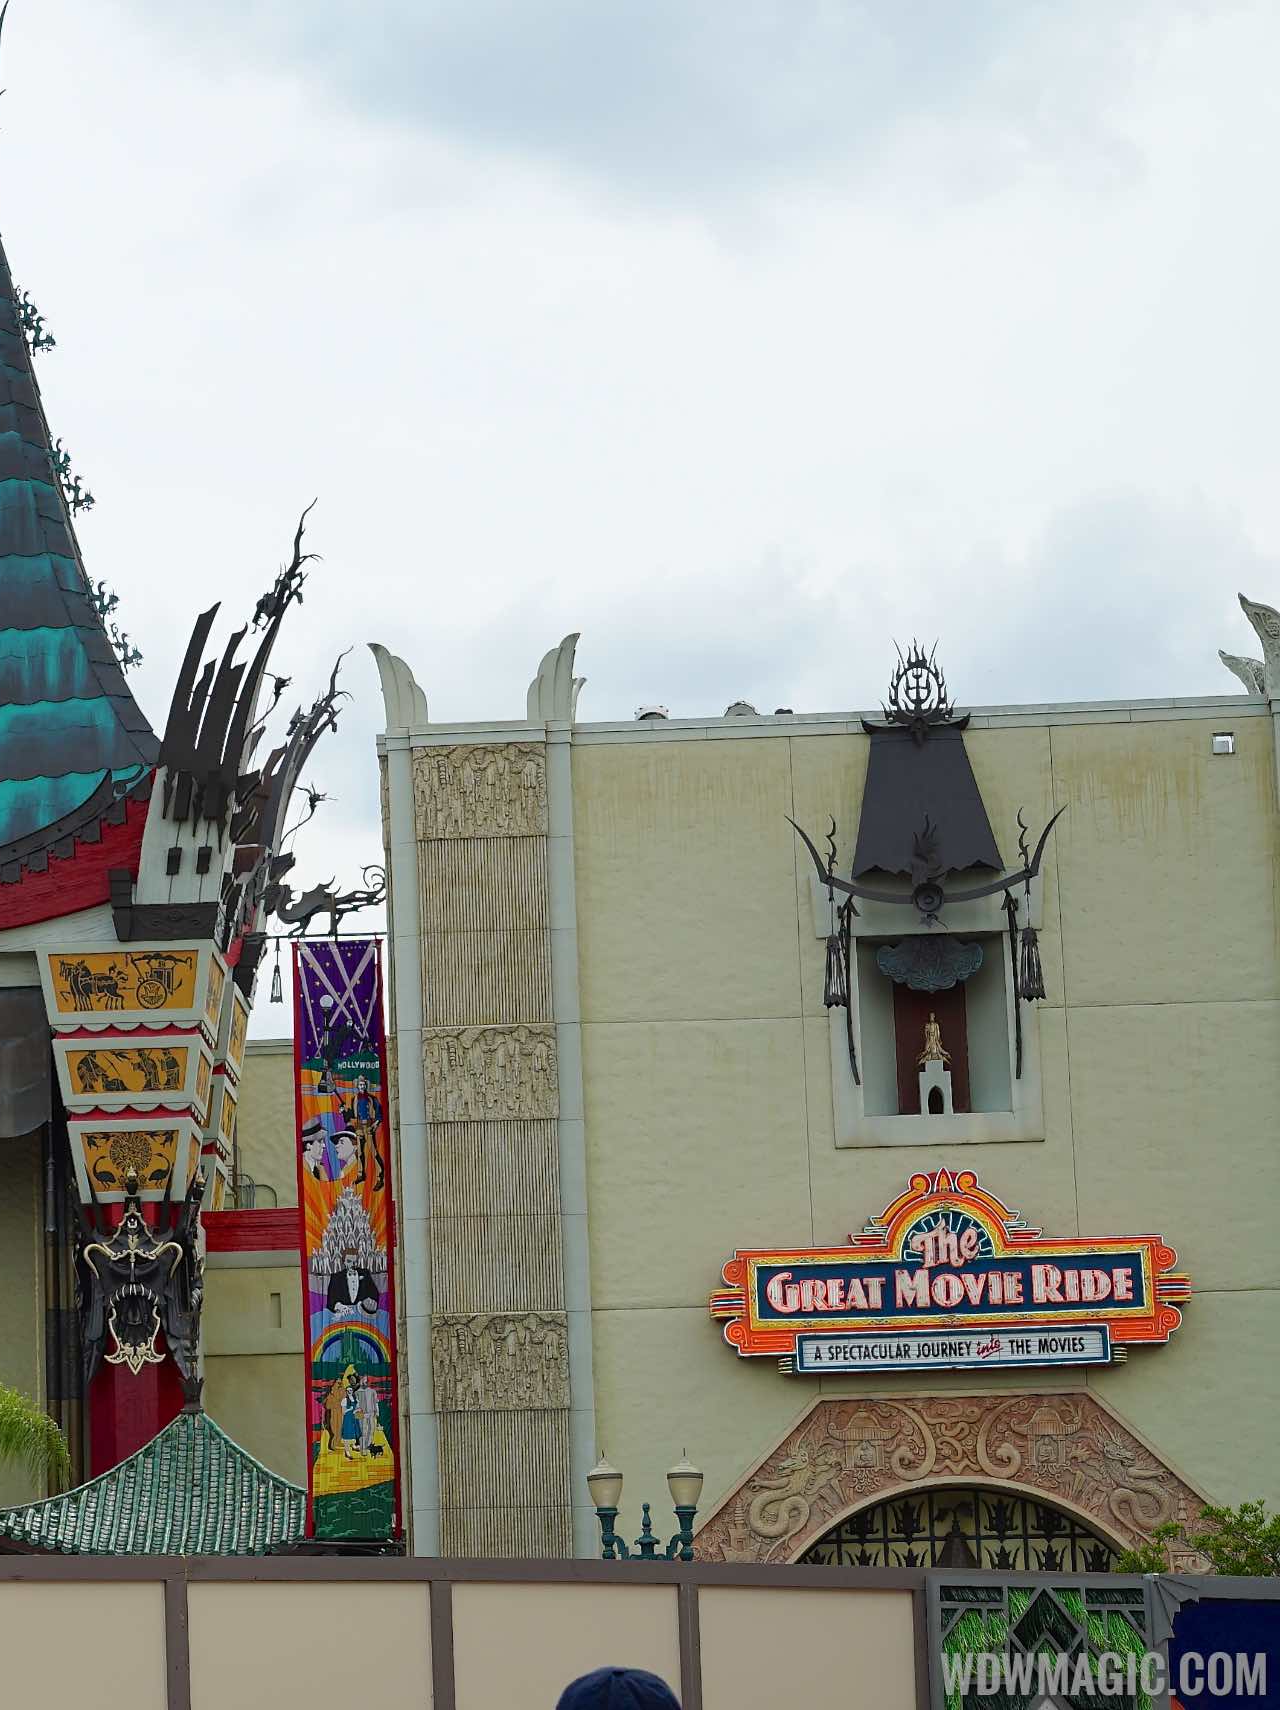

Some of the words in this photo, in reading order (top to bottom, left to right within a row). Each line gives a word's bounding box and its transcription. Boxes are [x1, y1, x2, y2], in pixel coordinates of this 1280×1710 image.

[911, 1219, 980, 1268] The
[766, 1272, 885, 1313] GREAT
[895, 1268, 1023, 1309] MOVIE
[1031, 1264, 1133, 1304] RIDE
[814, 1345, 823, 1361] A
[828, 1343, 911, 1361] SPECTACULAR
[915, 1340, 972, 1359] JOURNEY
[976, 1333, 1003, 1359] into
[1008, 1338, 1032, 1356] THE
[1038, 1336, 1085, 1354] MOVIES
